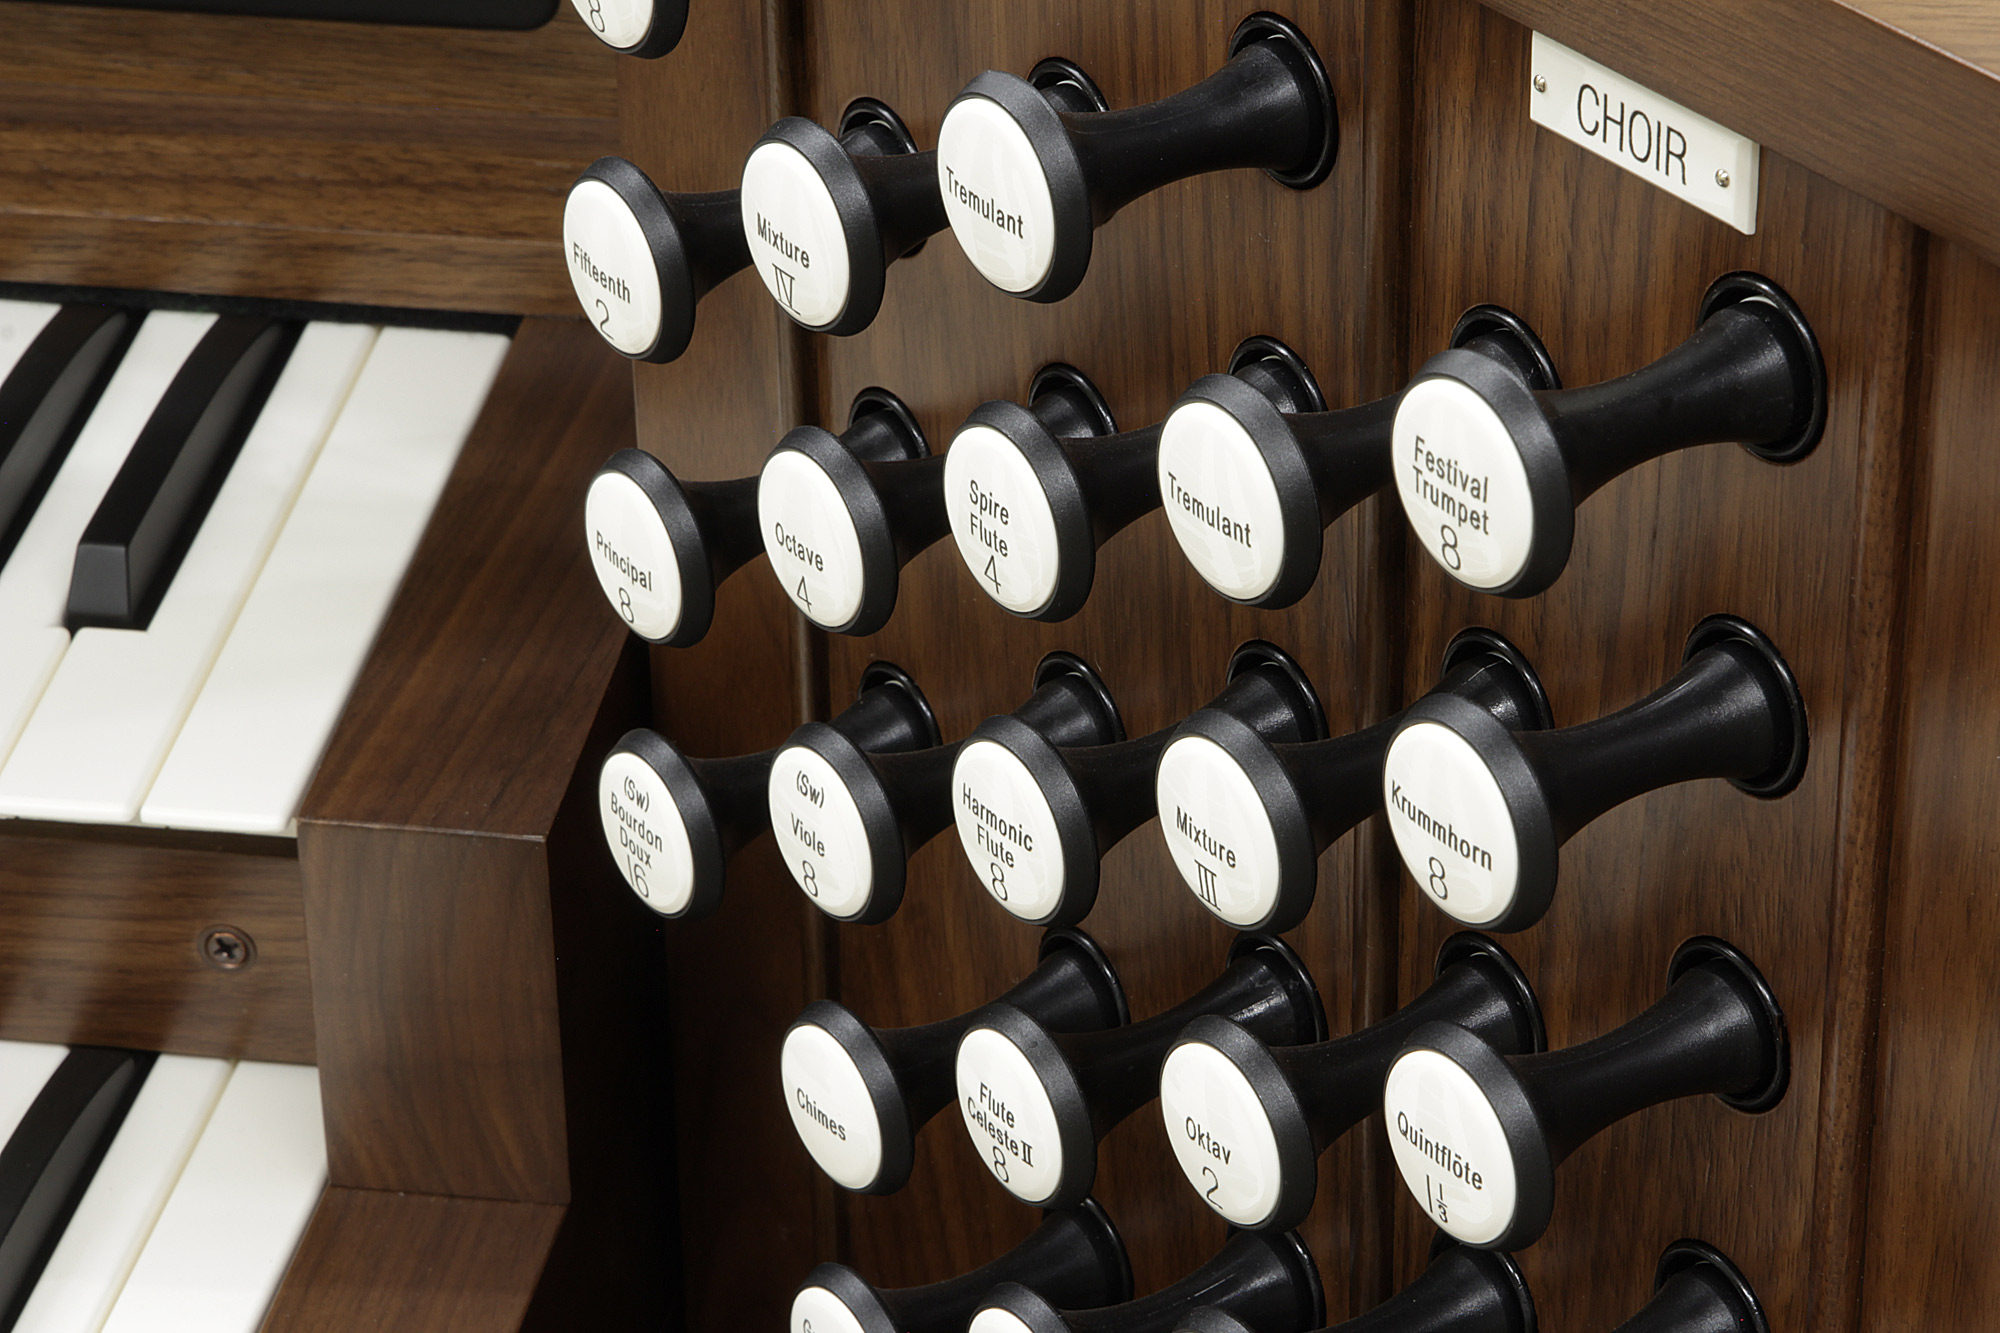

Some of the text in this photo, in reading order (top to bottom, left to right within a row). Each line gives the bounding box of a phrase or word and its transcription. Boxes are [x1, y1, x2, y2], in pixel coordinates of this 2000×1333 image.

[587, 0, 606, 33] 8
[1577, 83, 1688, 186] CHOIR
[945, 165, 1025, 240] Tremulant
[757, 212, 811, 269] Mixture
[572, 242, 632, 304] Fifteenth
[594, 298, 615, 340] 2
[1413, 435, 1490, 503] Festival
[969, 479, 1010, 526] Spire
[1167, 471, 1253, 549] Tremulant
[1412, 465, 1490, 536] Trumpet
[774, 521, 825, 573] Octave
[969, 512, 1009, 558] Flute
[1440, 524, 1462, 571] 8
[595, 530, 653, 593] Principal
[983, 554, 1002, 595] 4
[618, 587, 635, 624] 8
[795, 575, 813, 613] 4
[623, 775, 651, 813] (Sw)
[795, 769, 826, 810] (Sw)
[610, 791, 664, 853] Bourdon
[790, 813, 826, 858] Viole
[961, 782, 1034, 853] Harmonic
[1175, 805, 1237, 869] Mixture
[1390, 779, 1493, 872] Krummhorn
[619, 825, 653, 870] Doux
[976, 823, 1016, 869] Flute
[626, 854, 651, 899] 16
[802, 860, 819, 899] 8
[990, 861, 1009, 902] 8
[1194, 859, 1222, 912] III
[1428, 856, 1449, 901] 8
[796, 1087, 847, 1142] Chimes
[979, 1081, 1016, 1129] Flute
[991, 1145, 1010, 1184] 8
[1185, 1116, 1232, 1166] Oktav
[1397, 1111, 1484, 1192] Quintflöte
[1202, 1166, 1224, 1210] 2
